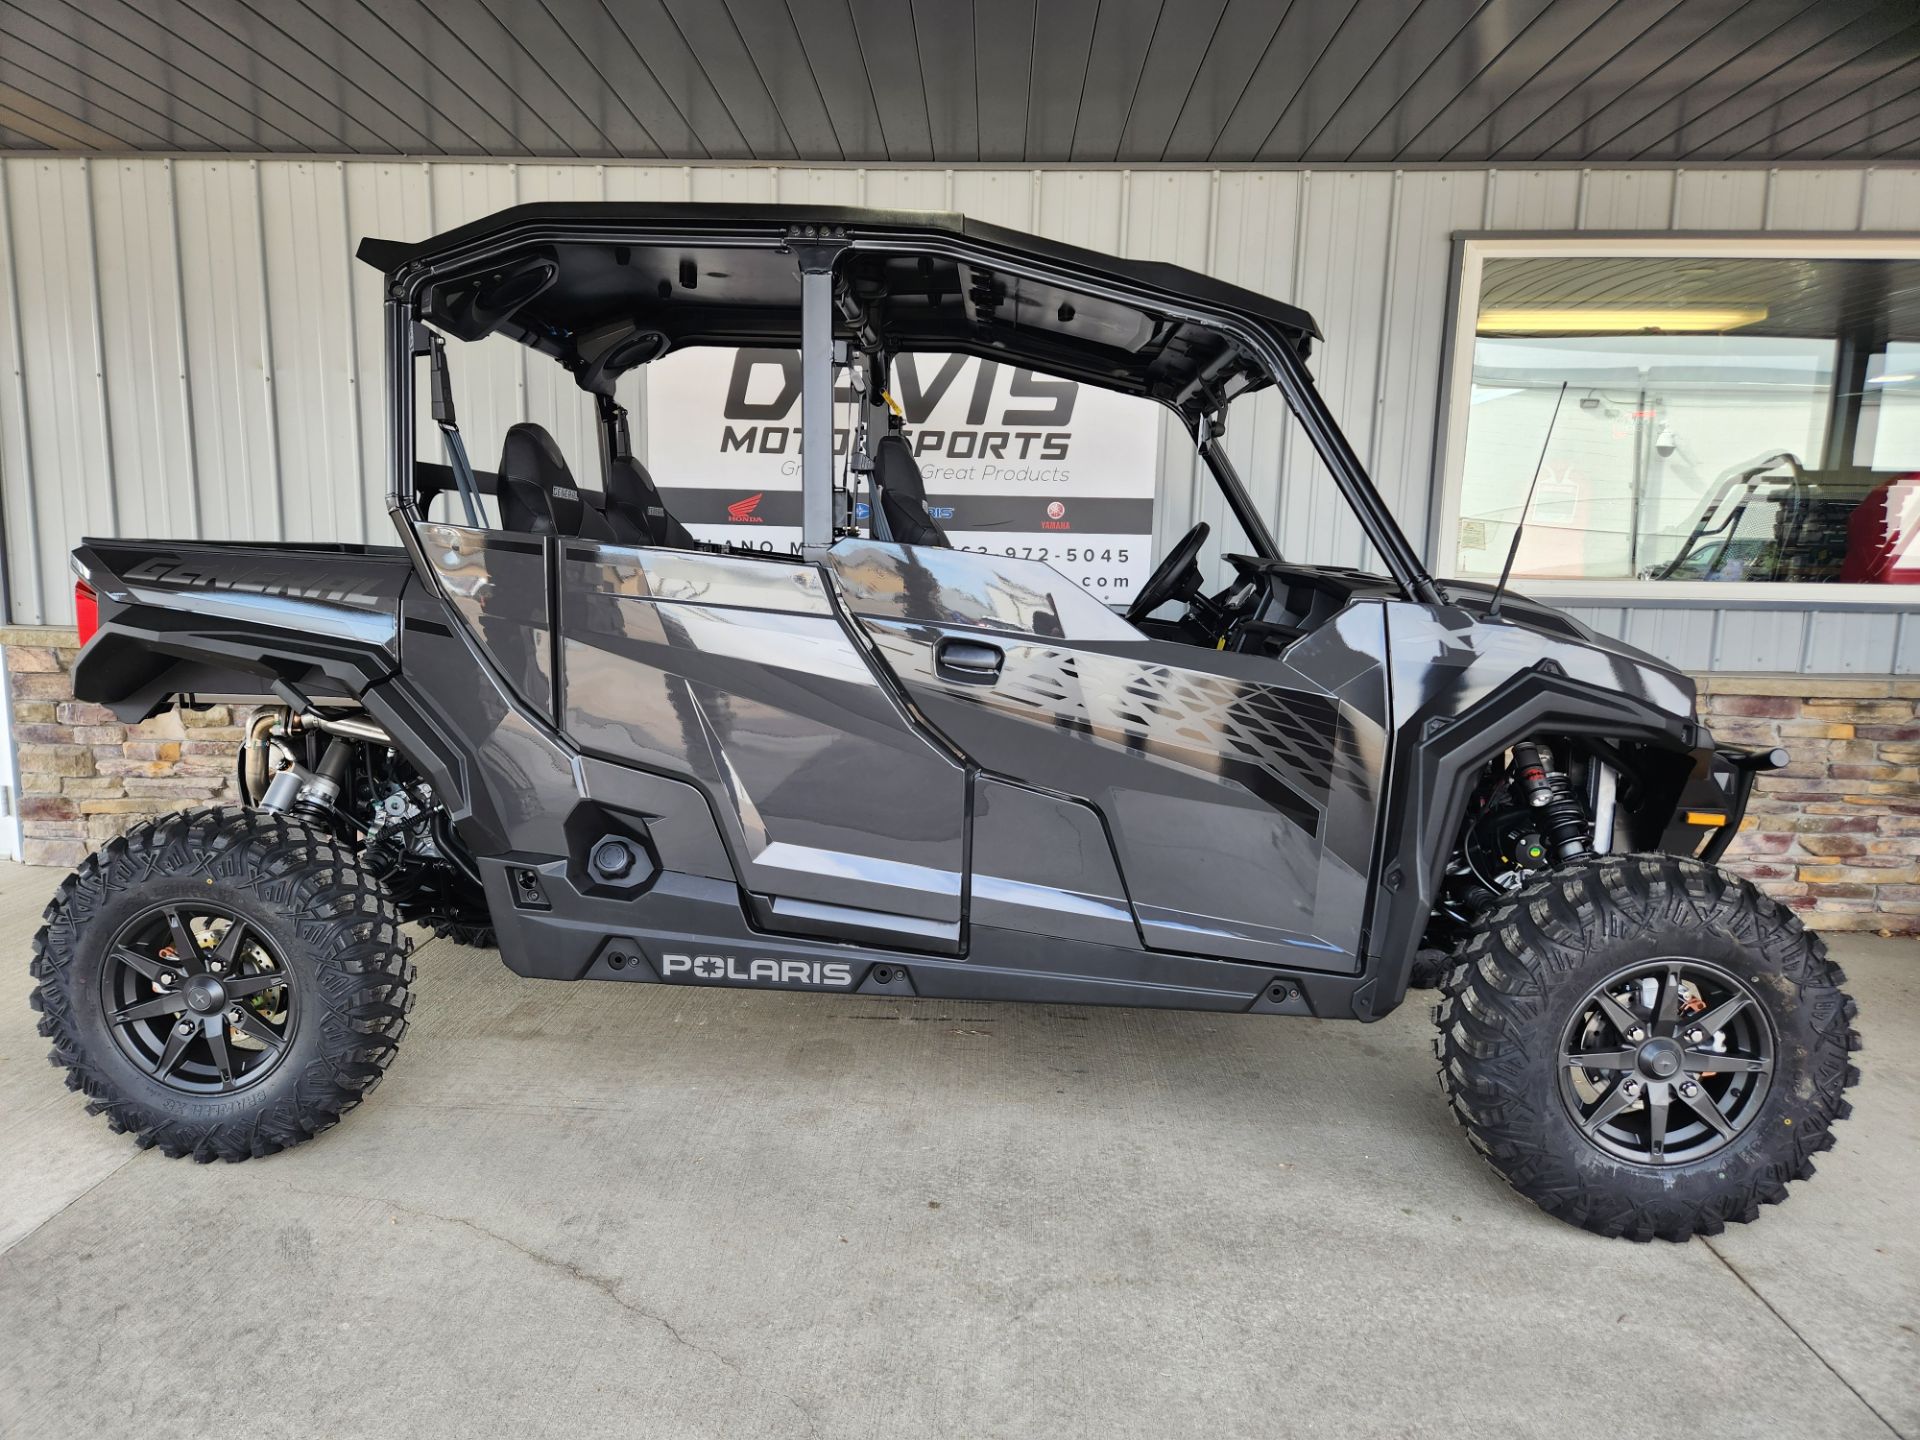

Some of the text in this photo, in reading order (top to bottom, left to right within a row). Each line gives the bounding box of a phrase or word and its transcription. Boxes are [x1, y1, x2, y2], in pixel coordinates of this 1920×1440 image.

[921, 464, 1070, 482] Great Products
[728, 515, 764, 523] HONDA
[1041, 521, 1071, 529] YAMAHA
[122, 556, 385, 605] GENERAL
[662, 954, 852, 986] POLARIS
